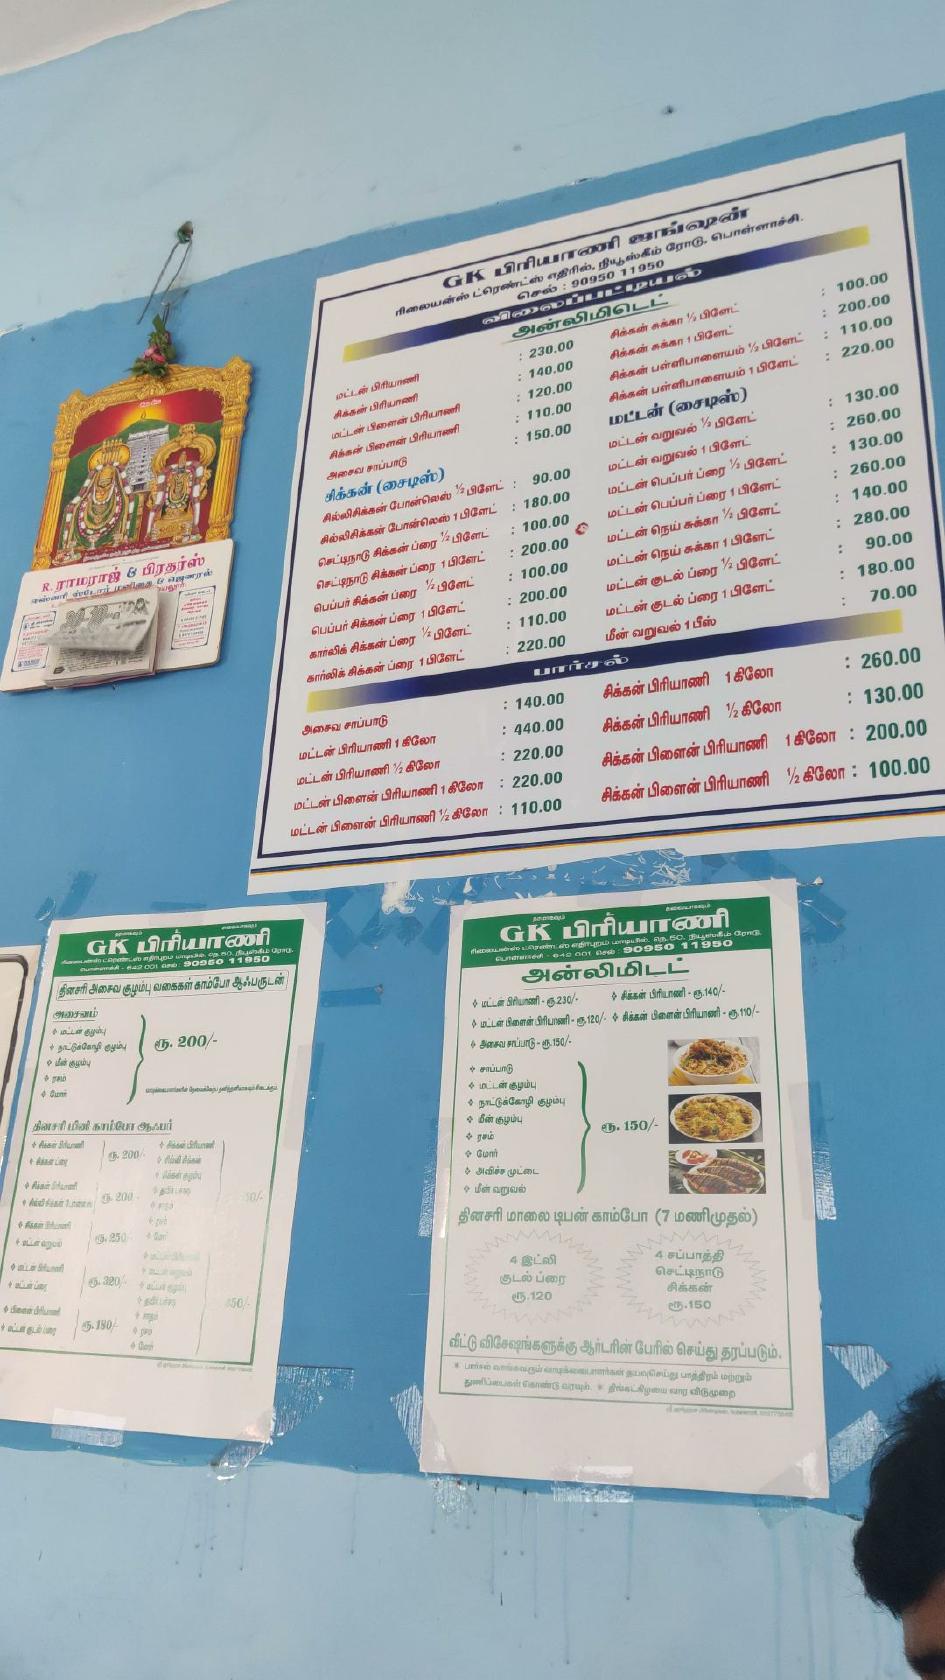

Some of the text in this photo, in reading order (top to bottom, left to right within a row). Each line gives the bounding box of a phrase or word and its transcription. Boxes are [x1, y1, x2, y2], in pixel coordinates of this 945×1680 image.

[442, 206, 749, 289] GK பிரியாணி ஜங்ஷன்
[395, 292, 470, 317] ரிலையன்ஸ்
[472, 275, 544, 298] ட்ரெண்ட்ஸ்
[598, 246, 662, 271] நியூஸ்கீம்
[517, 260, 664, 300] செல் 90950 11950
[482, 267, 702, 325] விலைப்பட்டியல்
[512, 293, 669, 342] அன்லிமிடெட்
[610, 343, 648, 360] சிக்கன்
[651, 338, 684, 351] சுக்கா
[694, 325, 733, 342] பிளேட்
[838, 294, 891, 314] 200.00
[336, 339, 574, 401] மட்டன் பிரியாணி 230.00
[333, 360, 573, 420] சிக்கன் பிரியாணி 140.00
[331, 381, 572, 440] மட்டன் பிளைன் பிரியாணி 120.00
[609, 387, 747, 426] மட்டன் (சைடிஸ்)
[329, 402, 572, 460] சிக்கன் பிளைன் பிரியாணி 110.00
[608, 455, 648, 472] மட்டன்
[650, 445, 698, 466] வறுவல்
[709, 436, 752, 453] பிளேட்
[846, 407, 901, 428] 260.00
[326, 423, 572, 481] அசைவ சாப்பாடு 150.00
[325, 467, 445, 503] சிக்கன் (சைடிஸ்)
[42, 583, 53, 593] R.
[55, 567, 122, 592] ராமராஜ்
[127, 566, 138, 578] &
[142, 553, 206, 578] பிரதர்ஸ்
[311, 620, 348, 635] பெப்பர்
[350, 614, 388, 630] சிக்கன்
[389, 612, 416, 624] ப்ரை
[427, 601, 466, 618] பிளேட்
[519, 586, 567, 604] 200.00
[605, 627, 629, 642] மீன்
[632, 620, 682, 641] வறுவல்
[692, 615, 717, 629] பீஸ்
[870, 584, 917, 602] 70.00
[533, 655, 630, 676] பார்சல்
[603, 680, 645, 699] சிக்கன்
[648, 671, 710, 694] பிரியாணி
[733, 666, 774, 683] கிலோ
[861, 647, 921, 669] 260.00
[302, 692, 564, 736] அசைவ சாப்பாடு 140.00
[299, 745, 336, 760] மட்டன்
[338, 738, 392, 755] பிரியாணி
[401, 734, 437, 747] கிலோ
[514, 718, 564, 736] 440.00
[501, 908, 731, 943] GK பிரியாணி
[87, 928, 271, 956] GK பிரியாணி
[623, 939, 733, 954] 90950 11950
[183, 955, 270, 967] 90950 11950
[58, 973, 285, 998] தினசரி அசைவ குழம்பு வகைகள் காம்போ ஆஃபருடன்
[52, 1006, 99, 1020] அசைவம்
[622, 1010, 648, 1022] சிக்கன்
[650, 1007, 683, 1021] பிளைன்
[683, 1006, 721, 1020] பிரியாணி
[728, 1004, 760, 1020] ரூ.110/-
[60, 1026, 107, 1038] மட்டன் குழம்பு
[104, 1040, 127, 1053] குழம்பு
[154, 1034, 218, 1052] ரூ. 200/-
[55, 1056, 91, 1069] மீன் குழம்பு
[479, 1063, 514, 1075] சாப்பாடு
[51, 1073, 67, 1084] ரசம்
[479, 1079, 536, 1091] மட்டன் குழம்பு
[478, 1095, 566, 1110] நாட்டுக்கோழி குழம்பு
[31, 1118, 173, 1133] தினசரி மினி காம்போ ஆஃபர்
[478, 1113, 523, 1126] மீன் குழம்பு
[601, 1118, 659, 1134] ரூ. 150/-
[477, 1130, 494, 1143] ரசம்
[476, 1148, 498, 1158] மோர்
[475, 1165, 540, 1178] அவிச்ச முட்டை
[474, 1182, 528, 1197] மீன் வறுவல்
[458, 1206, 758, 1229] தினசரி மாலை டிபன் காம்போ (7 மணிமுதல்)
[509, 1253, 557, 1268] 4 இட்லி
[654, 1249, 725, 1264] 4 சப்பாத்தி
[499, 1270, 567, 1287] குடல் ப்ரை
[654, 1264, 725, 1280] செட்டிநாடு
[511, 1290, 553, 1304] ரூ.120
[665, 1280, 714, 1297] சிக்கன்
[668, 1299, 712, 1312] ரூ.150
[449, 1332, 782, 1364] வீட்டு விசேஷங்களுக்கு ஆர்டரின் பேரில் செய்து தரப்படும்.
[689, 1385, 736, 1401] விடுமுறை
